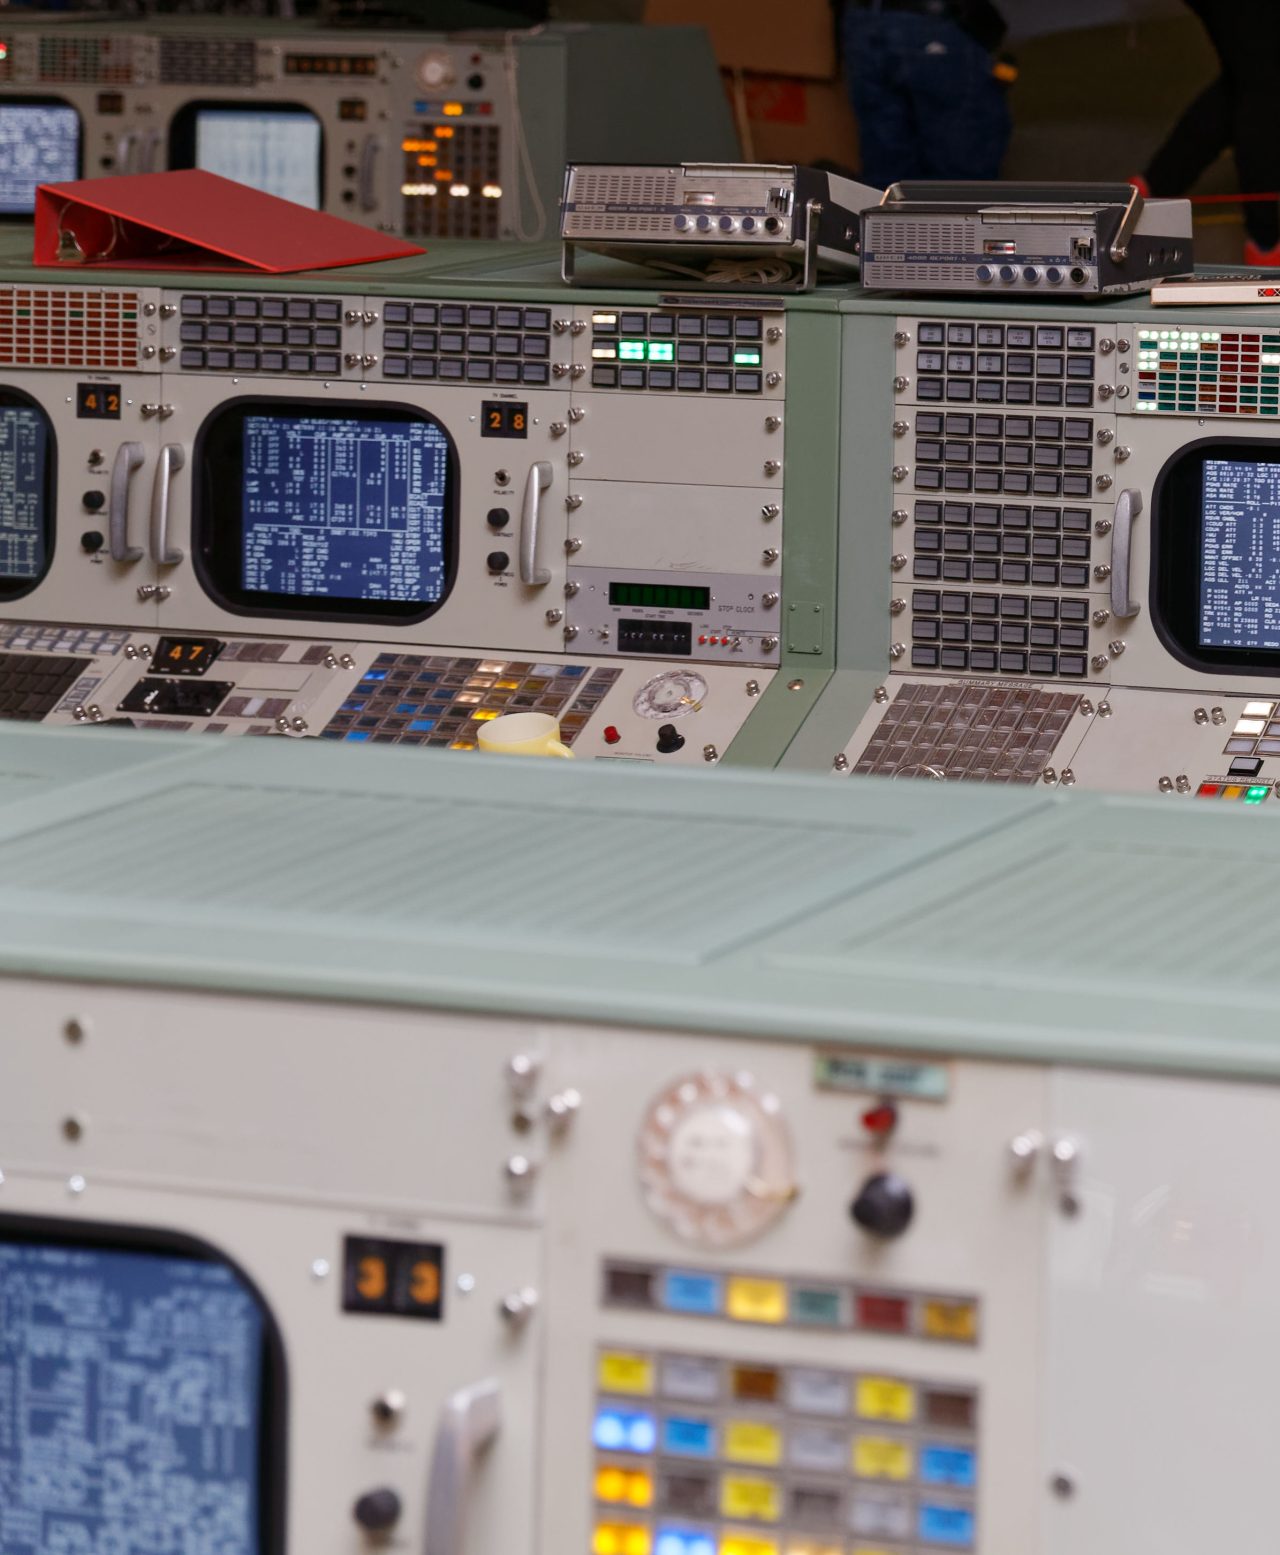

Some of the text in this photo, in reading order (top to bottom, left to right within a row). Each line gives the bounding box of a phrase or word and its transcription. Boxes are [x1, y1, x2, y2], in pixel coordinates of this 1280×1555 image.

[85, 394, 118, 411] 4 2
[490, 412, 524, 429] 2 8
[169, 646, 203, 660] 4 7
[357, 1255, 440, 1305] 3 3
